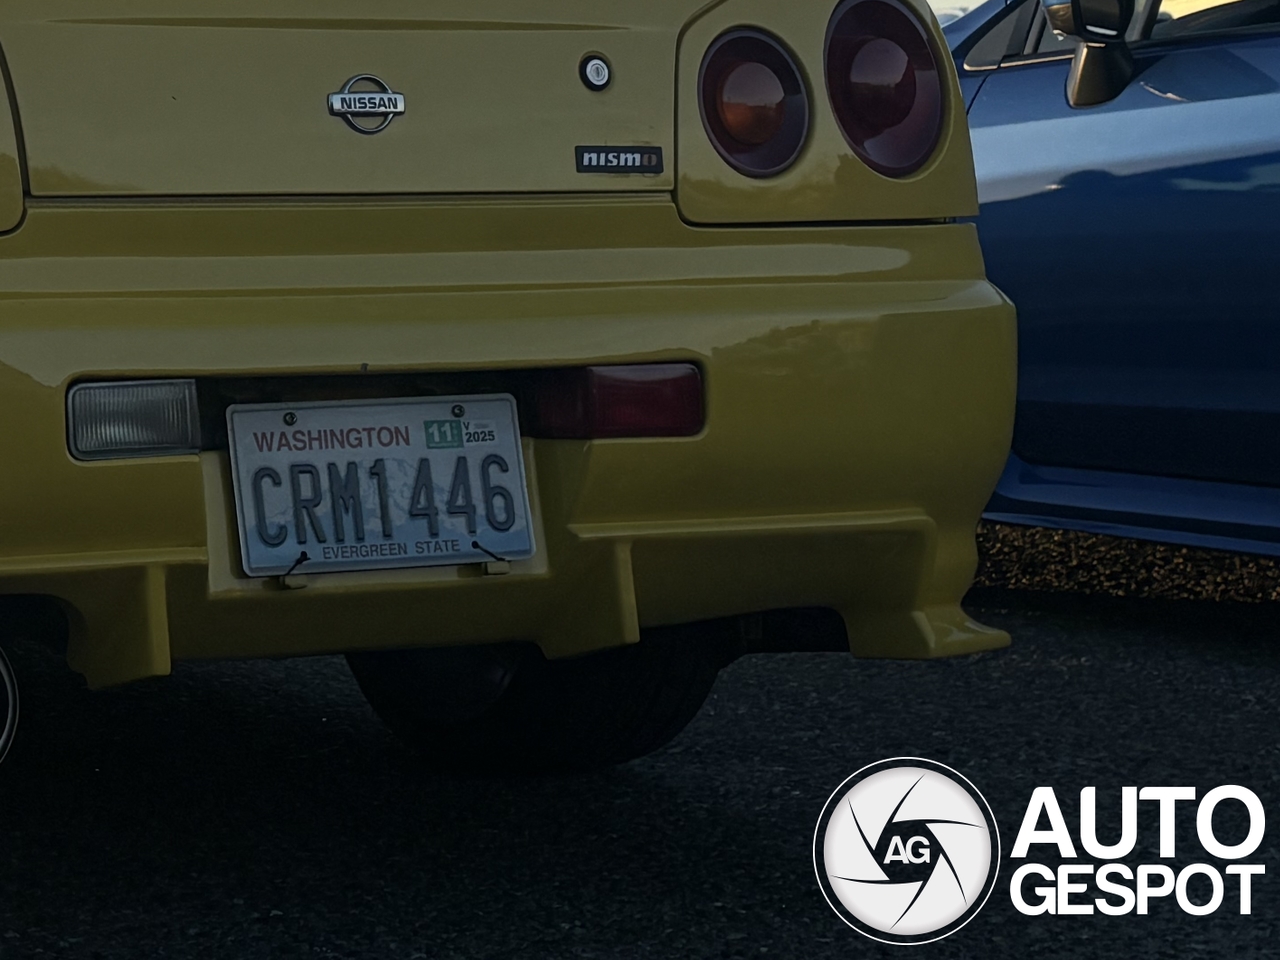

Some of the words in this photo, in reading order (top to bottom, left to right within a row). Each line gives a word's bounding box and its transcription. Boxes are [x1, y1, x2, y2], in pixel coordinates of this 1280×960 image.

[340, 96, 398, 110] NISSAN
[582, 151, 657, 166] nismo
[253, 426, 410, 452] WASHINGTON
[428, 422, 452, 442] 11
[465, 430, 495, 443] 2025
[252, 454, 515, 548] CRM1446
[322, 543, 408, 560] EVERGREEN
[415, 539, 460, 554] STATE
